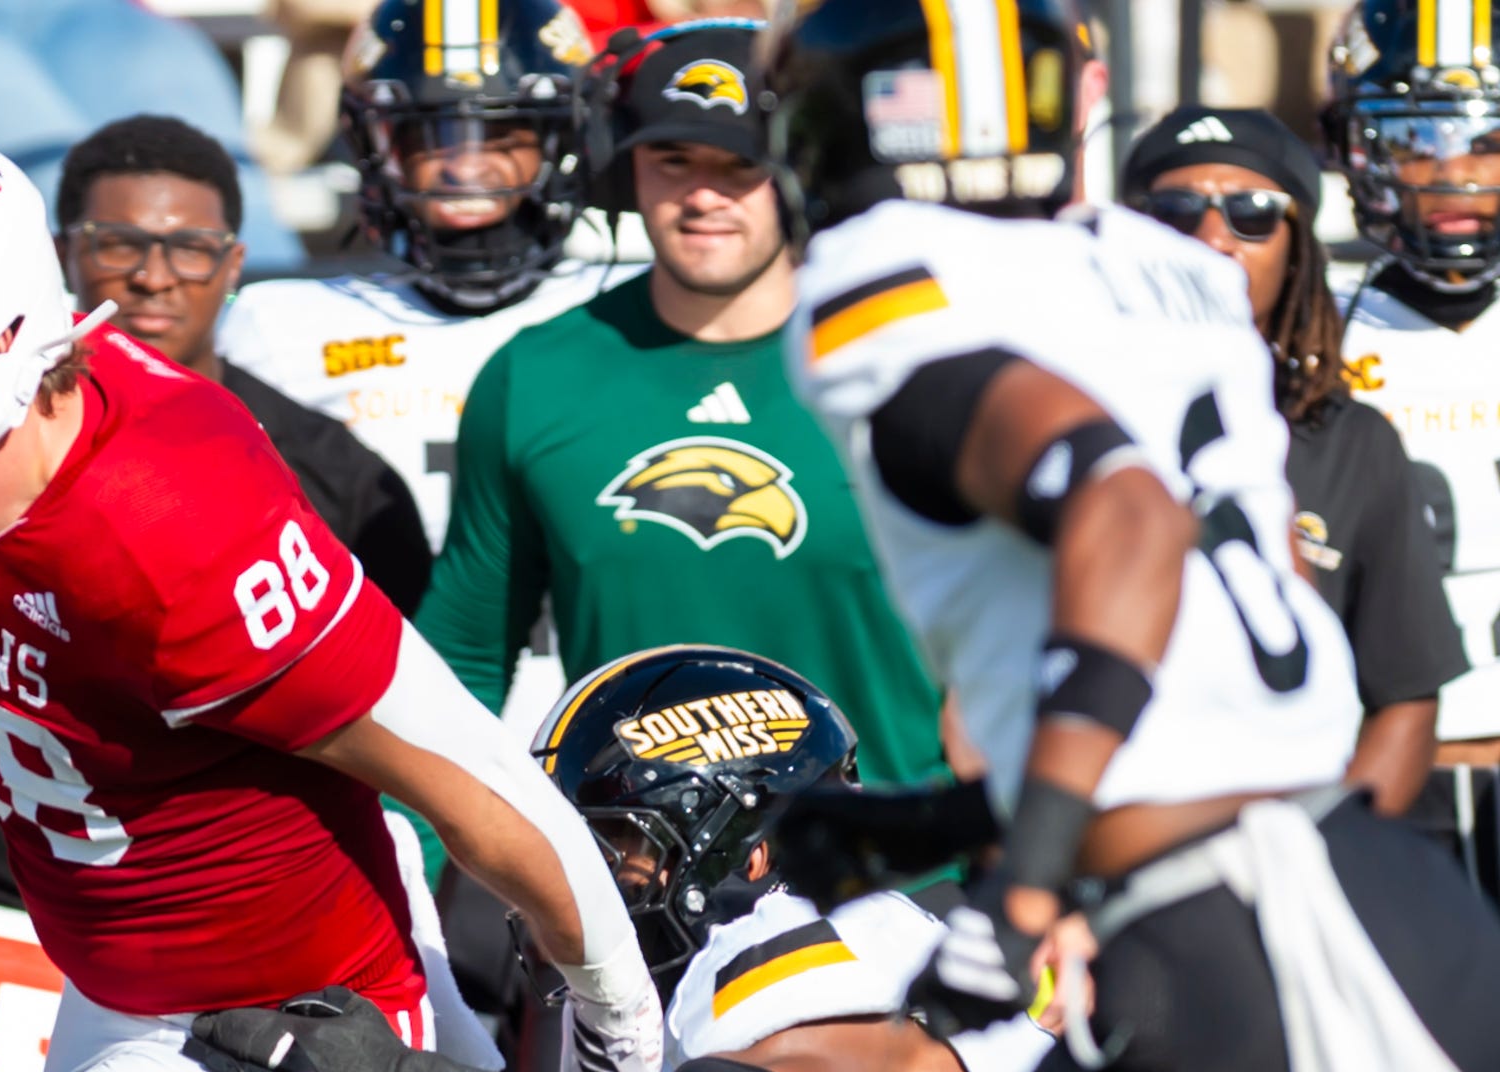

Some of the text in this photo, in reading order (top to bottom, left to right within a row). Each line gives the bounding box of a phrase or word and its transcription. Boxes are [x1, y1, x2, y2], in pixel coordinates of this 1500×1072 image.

[322, 334, 406, 378] SBC
[345, 388, 466, 430] SOUTH
[233, 519, 330, 650] 88
[12, 593, 71, 642] adidas
[619, 690, 808, 757] SOUTHERN
[693, 722, 780, 764] MISS
